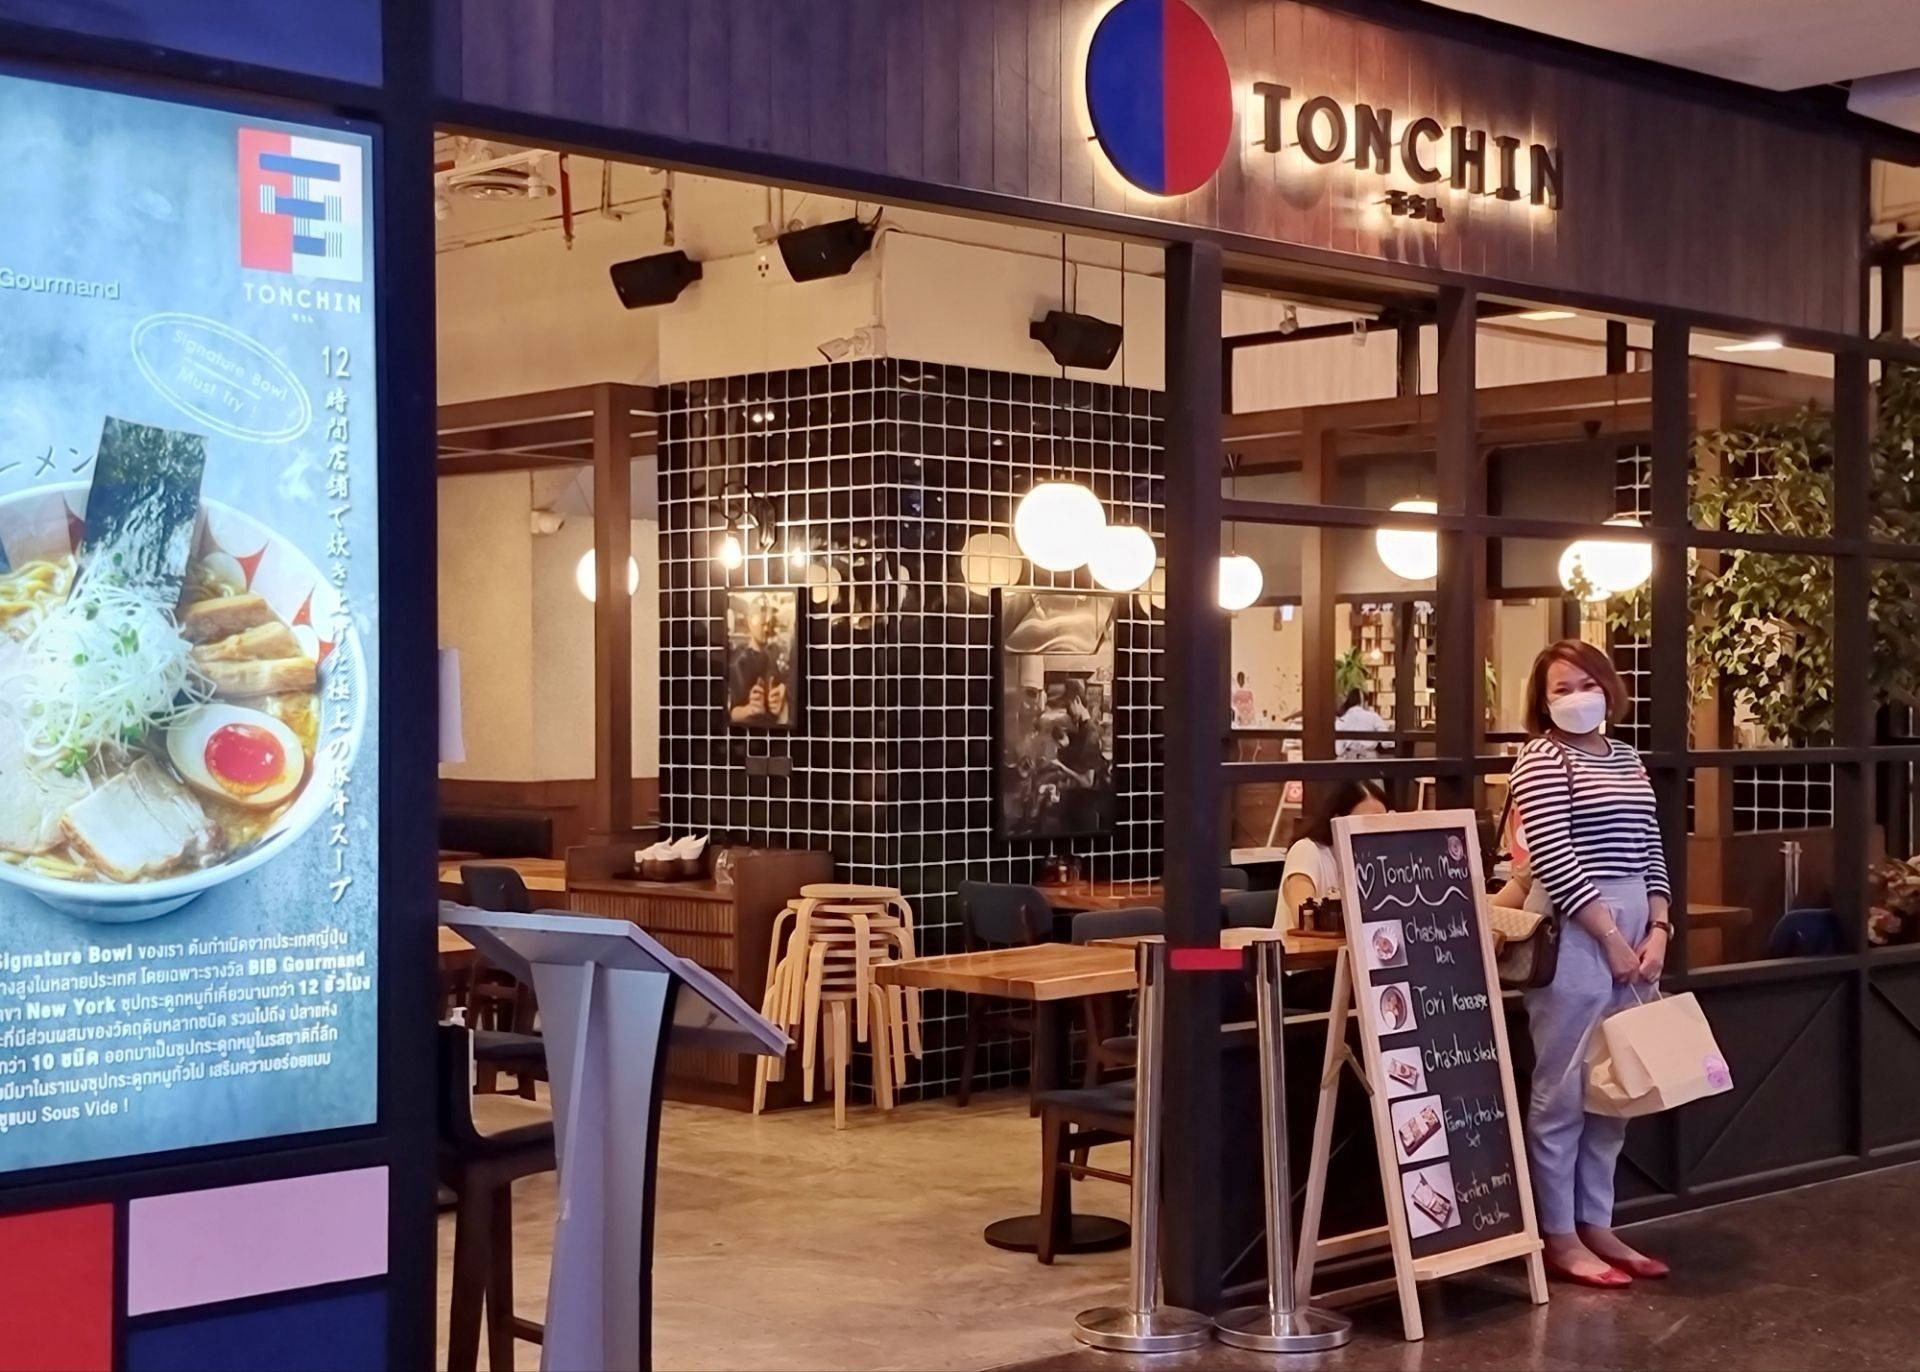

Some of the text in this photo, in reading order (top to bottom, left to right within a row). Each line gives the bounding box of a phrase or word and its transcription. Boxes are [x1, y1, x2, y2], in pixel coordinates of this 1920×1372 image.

[1253, 81, 1564, 211] TONCHIN
[0, 267, 120, 300] Gourmand
[243, 282, 361, 314] TONCHIN
[172, 329, 288, 401] Signature Bowl
[178, 365, 216, 397] Must
[222, 390, 245, 413] Try
[1376, 852, 1469, 888] Tonchin Menu
[1405, 912, 1447, 944] Chashu
[88, 943, 133, 965] Bowl
[138, 943, 184, 959] ของเรา
[248, 957, 277, 976] BIB
[282, 951, 366, 973] Gourmand
[1434, 945, 1456, 965] Don
[26, 1002, 66, 1020] New
[73, 996, 116, 1016] York
[299, 978, 319, 995] 12
[324, 970, 371, 994] ชั่วโมง
[1413, 985, 1446, 1020] Tori
[231, 1005, 286, 1026] รวมไปถึง
[290, 1000, 338, 1020] ปลาแห้ง
[32, 1053, 55, 1071] 10
[61, 1047, 99, 1069] ชนิด
[42, 1106, 80, 1122] Sous
[84, 1101, 118, 1117] Vide
[1444, 1097, 1472, 1132] Family
